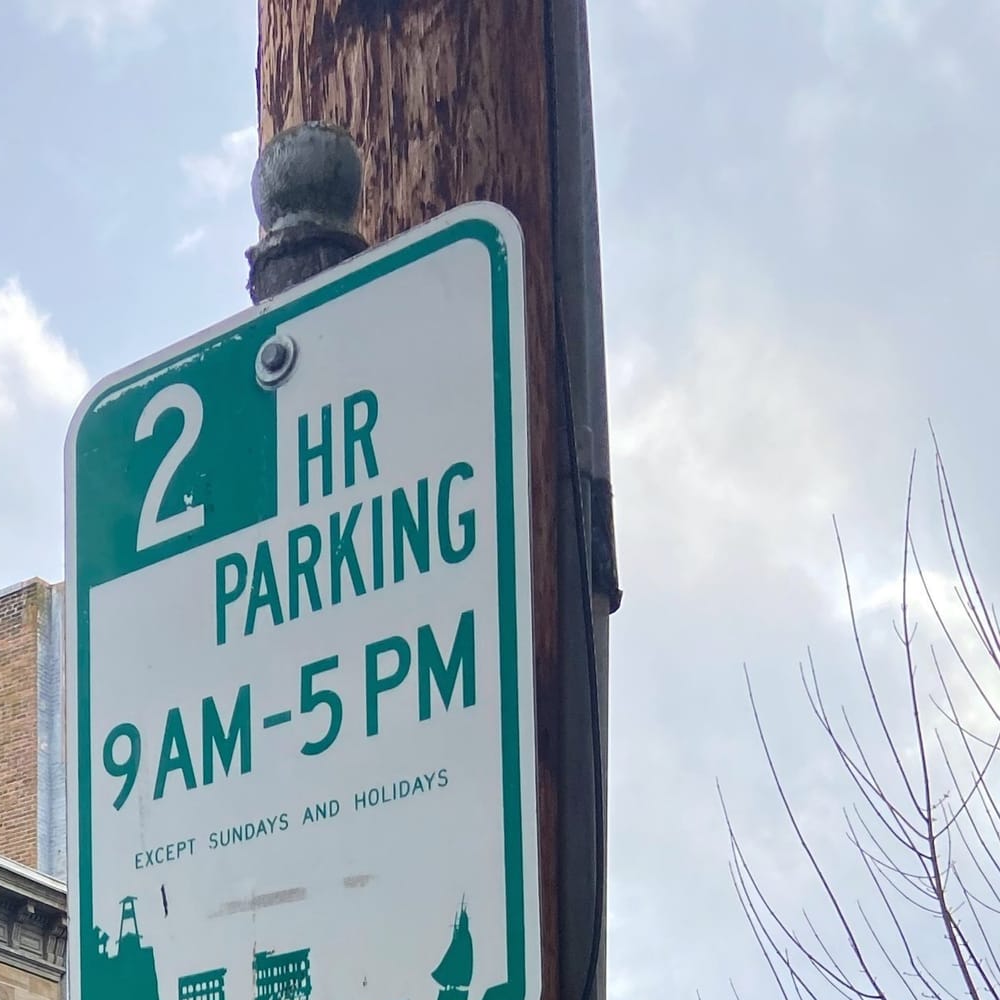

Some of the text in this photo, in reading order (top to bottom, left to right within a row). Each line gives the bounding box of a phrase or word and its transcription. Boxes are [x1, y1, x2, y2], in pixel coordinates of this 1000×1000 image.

[134, 382, 379, 552] 2 HR
[216, 461, 476, 646] PARKING
[135, 769, 449, 869] EXCEPT SUNDAYS AND HOLIDAYS
